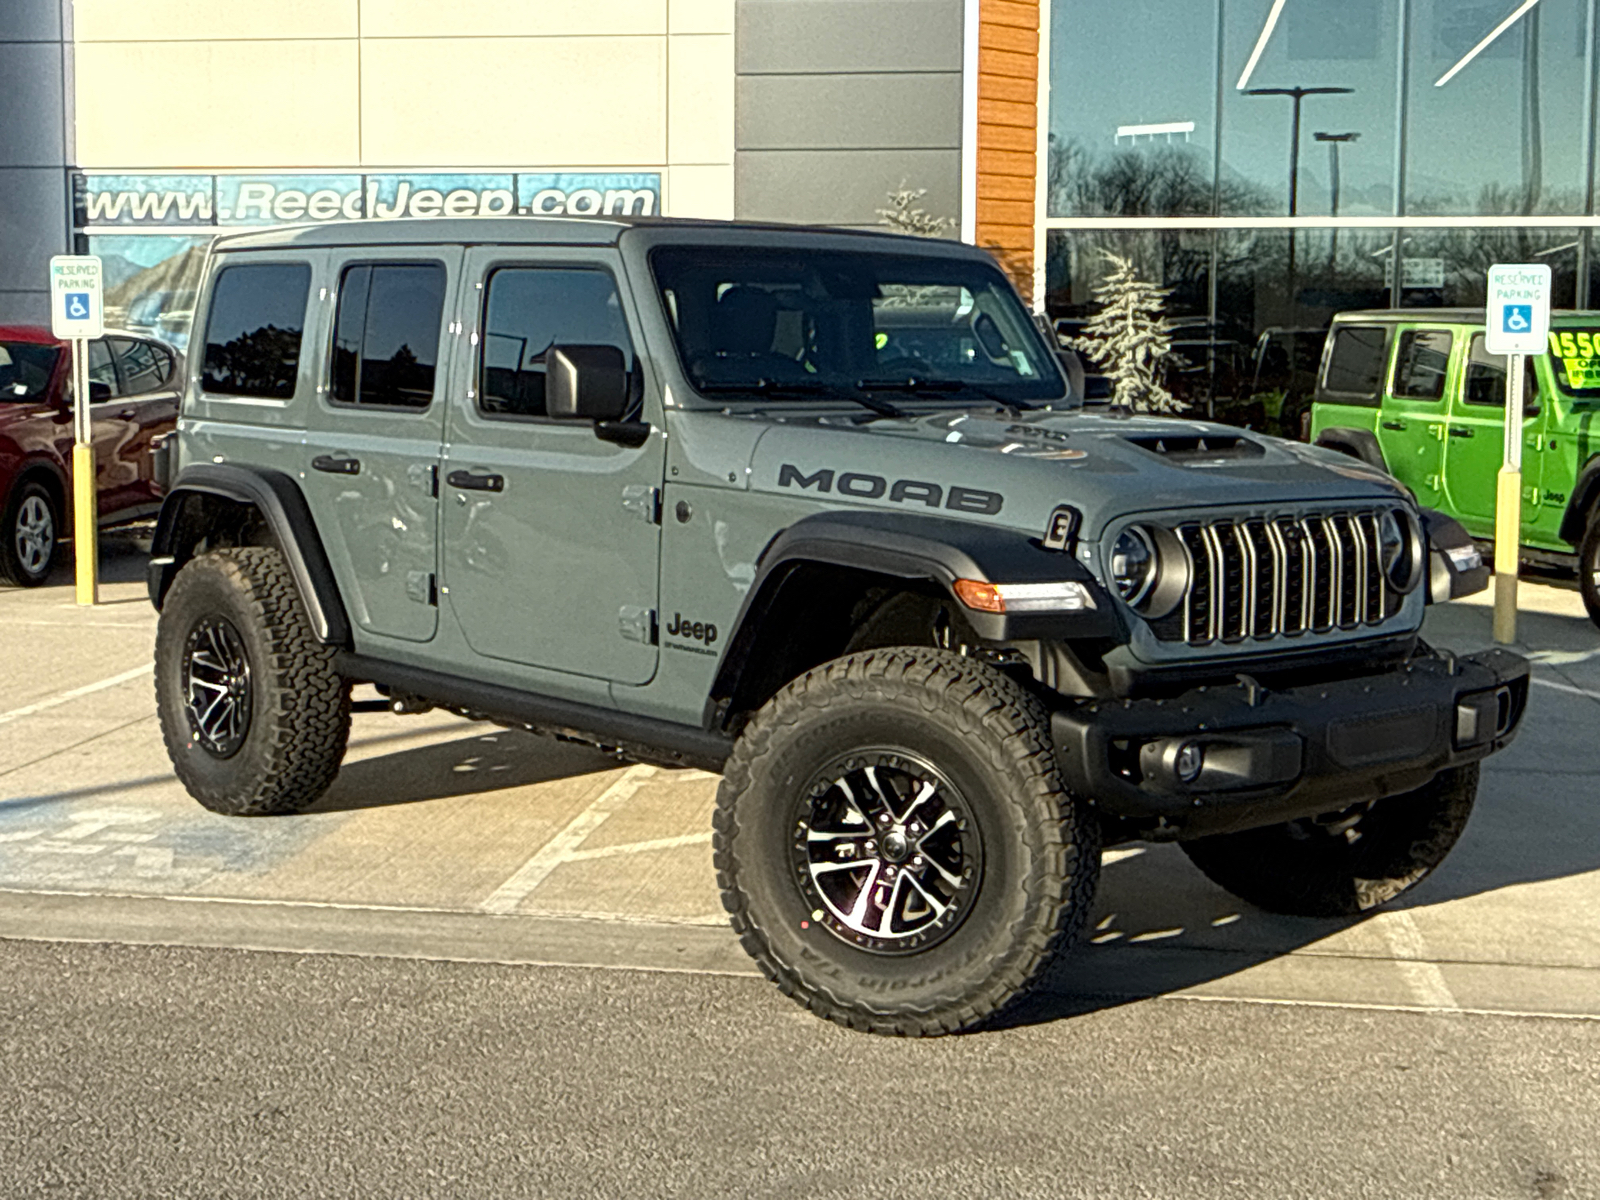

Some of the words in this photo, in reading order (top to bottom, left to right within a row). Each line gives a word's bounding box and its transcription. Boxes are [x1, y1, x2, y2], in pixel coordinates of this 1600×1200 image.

[86, 181, 655, 220] www.ReedJeep.com
[54, 265, 98, 276] RESERVED
[58, 278, 95, 290] PARKING
[1494, 274, 1545, 286] RESERVED
[1496, 289, 1541, 301] PARKING
[777, 463, 1004, 516] MOAB
[667, 612, 718, 646] Jeep
